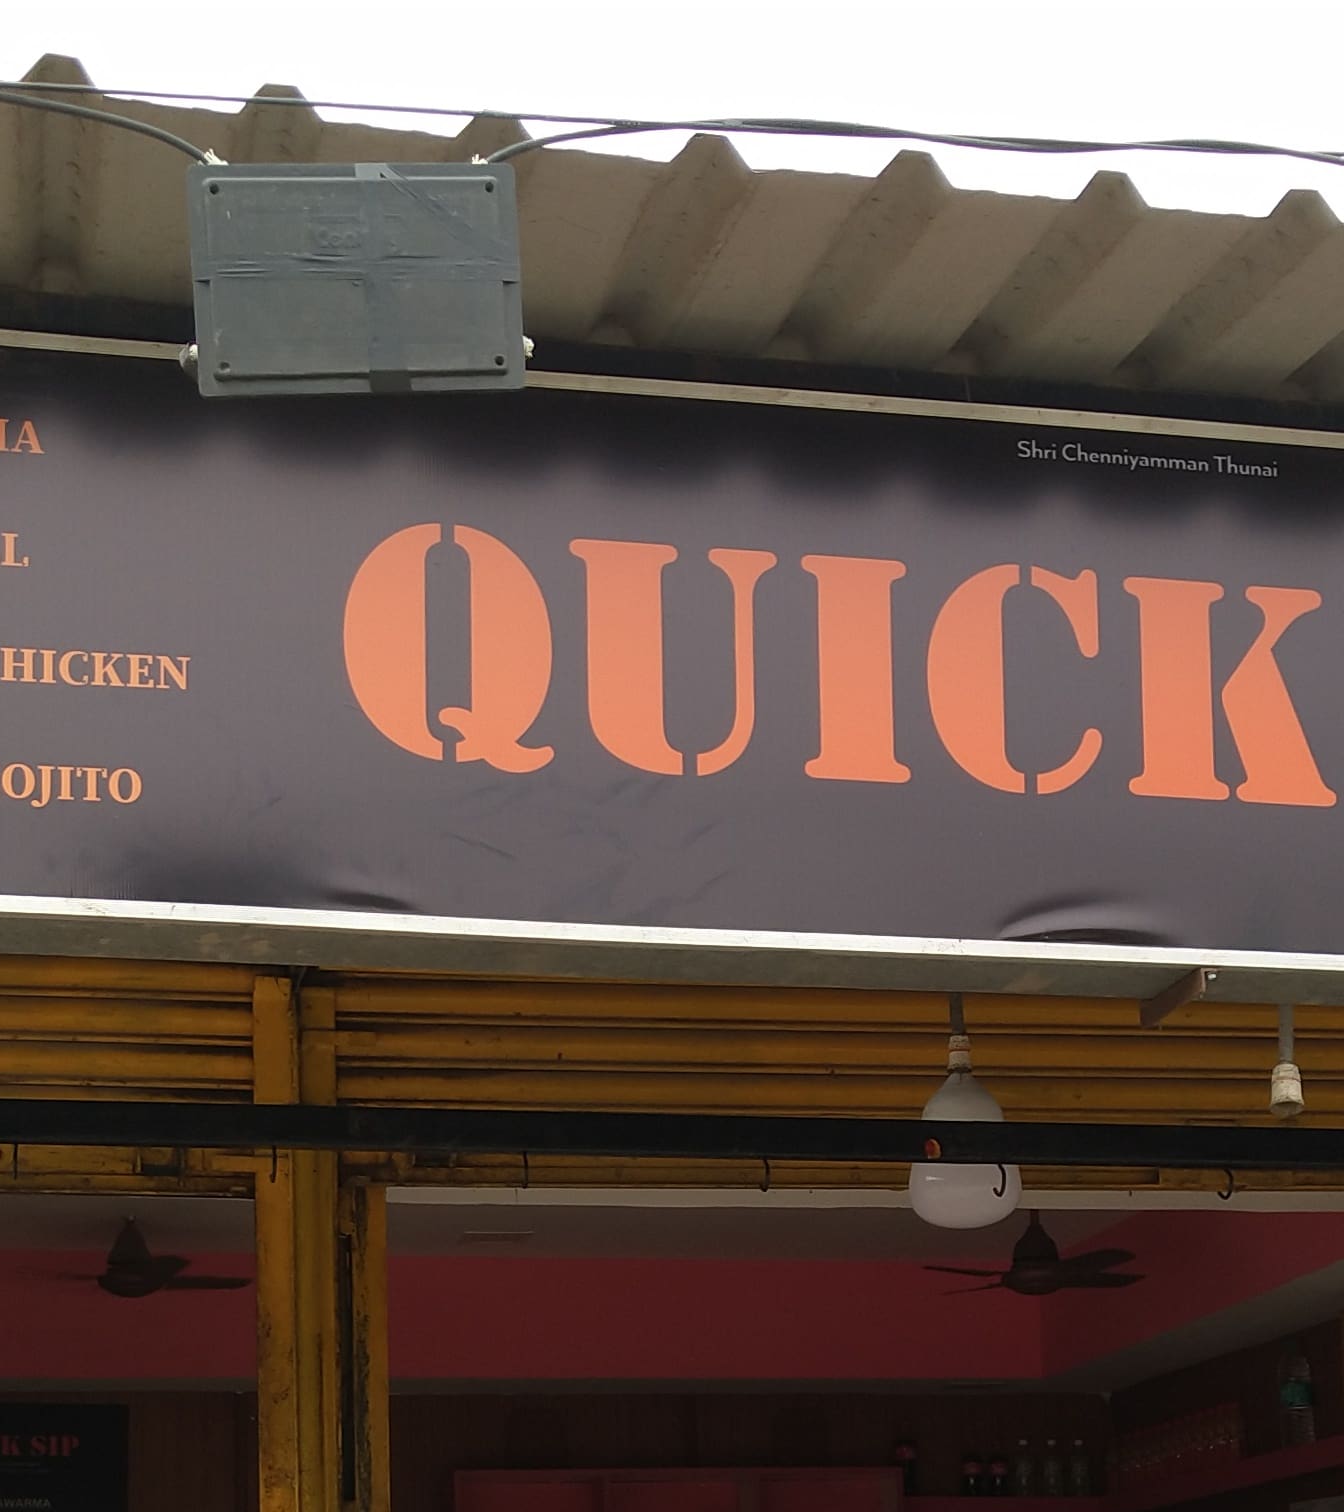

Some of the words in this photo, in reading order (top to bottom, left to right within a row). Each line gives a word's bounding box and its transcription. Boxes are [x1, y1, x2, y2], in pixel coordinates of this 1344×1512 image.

[1017, 440, 1057, 460] Shri
[1061, 443, 1209, 472] Chenniyamman
[1213, 456, 1279, 478] Thunai
[342, 522, 1338, 808] QUICK
[29, 1434, 80, 1457] SIP
